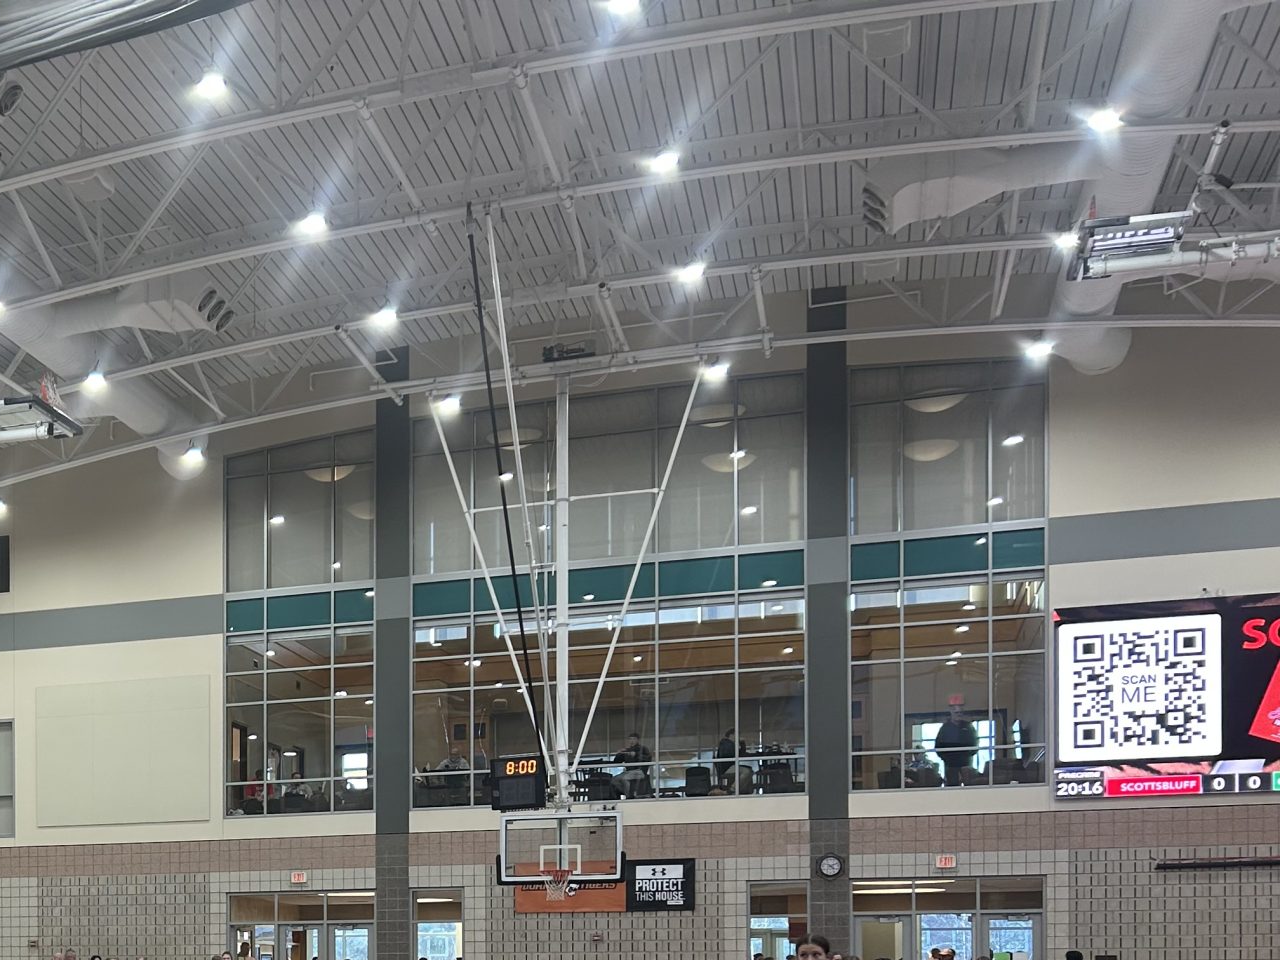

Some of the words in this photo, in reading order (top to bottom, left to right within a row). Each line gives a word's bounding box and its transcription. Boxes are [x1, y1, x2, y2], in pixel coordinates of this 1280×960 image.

[1122, 674, 1157, 685] SCAN
[1122, 685, 1157, 704] ME
[506, 759, 537, 775] 8:00
[1057, 781, 1104, 796] 20:16
[1120, 780, 1197, 792] SCOTTSBLUFF
[1213, 777, 1226, 791] 0
[1249, 775, 1262, 789] 0
[635, 879, 686, 891] PROTECT
[635, 891, 654, 901] THIS
